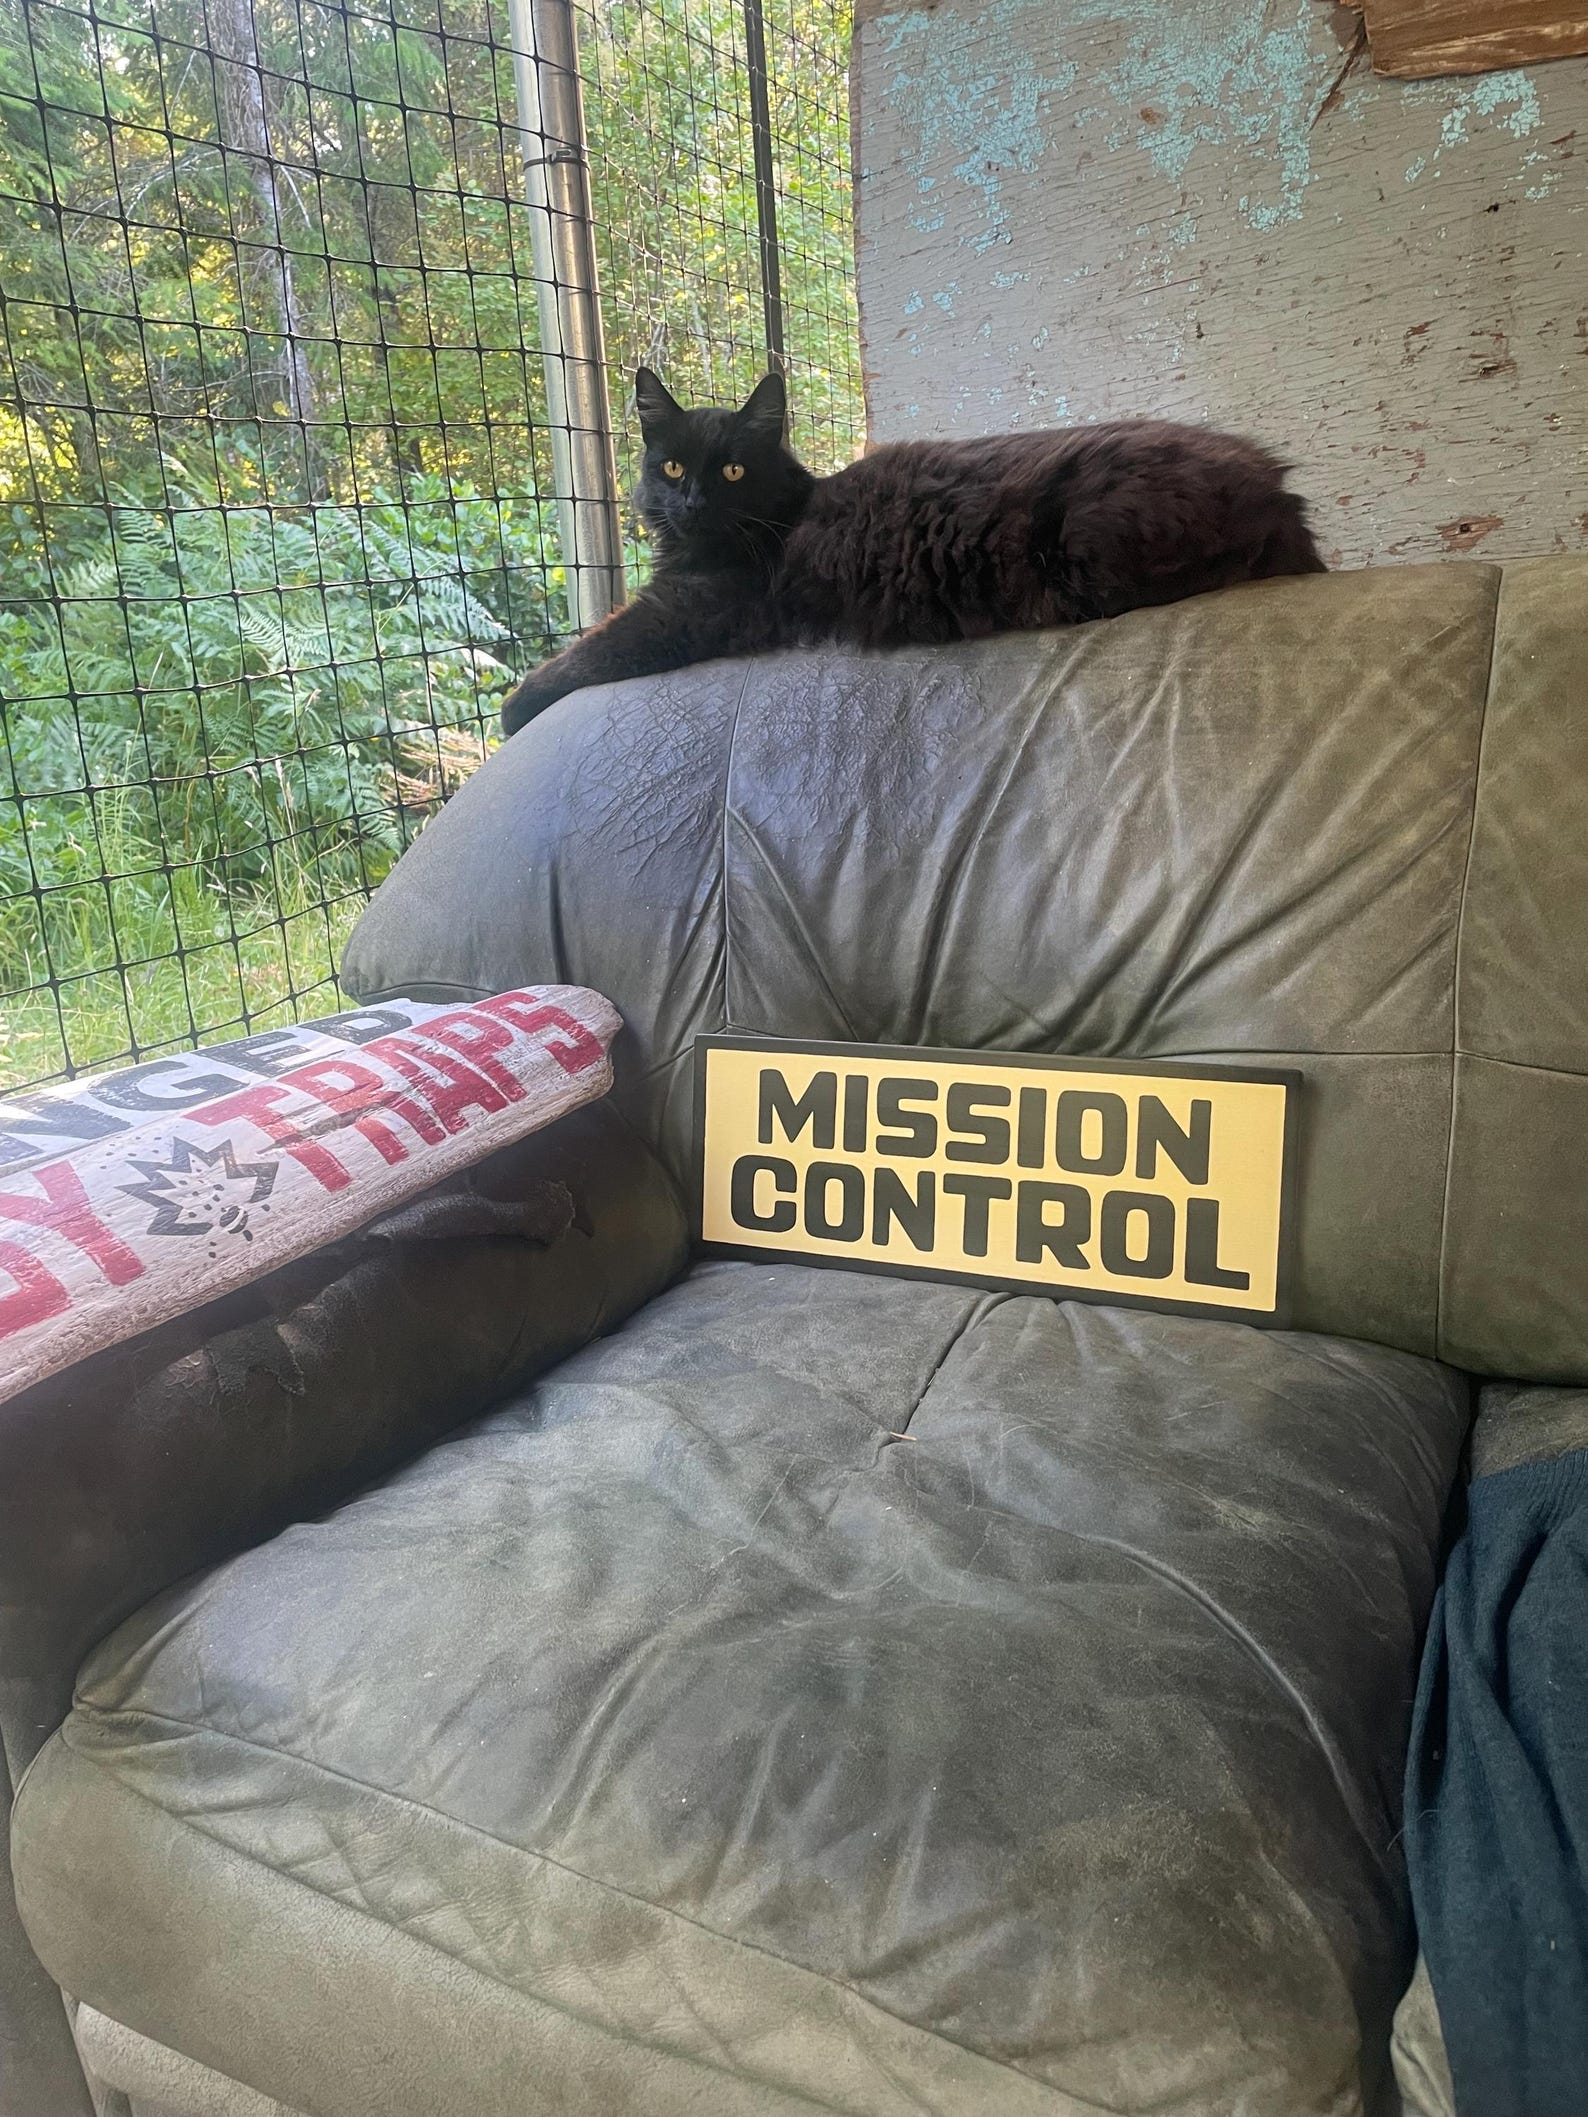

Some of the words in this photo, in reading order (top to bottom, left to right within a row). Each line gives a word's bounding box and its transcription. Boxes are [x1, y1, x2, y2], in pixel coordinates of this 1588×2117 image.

[182, 991, 602, 1192] TRAPS
[758, 1068, 1212, 1185] MISSION
[730, 1154, 1251, 1291] CONTROL
